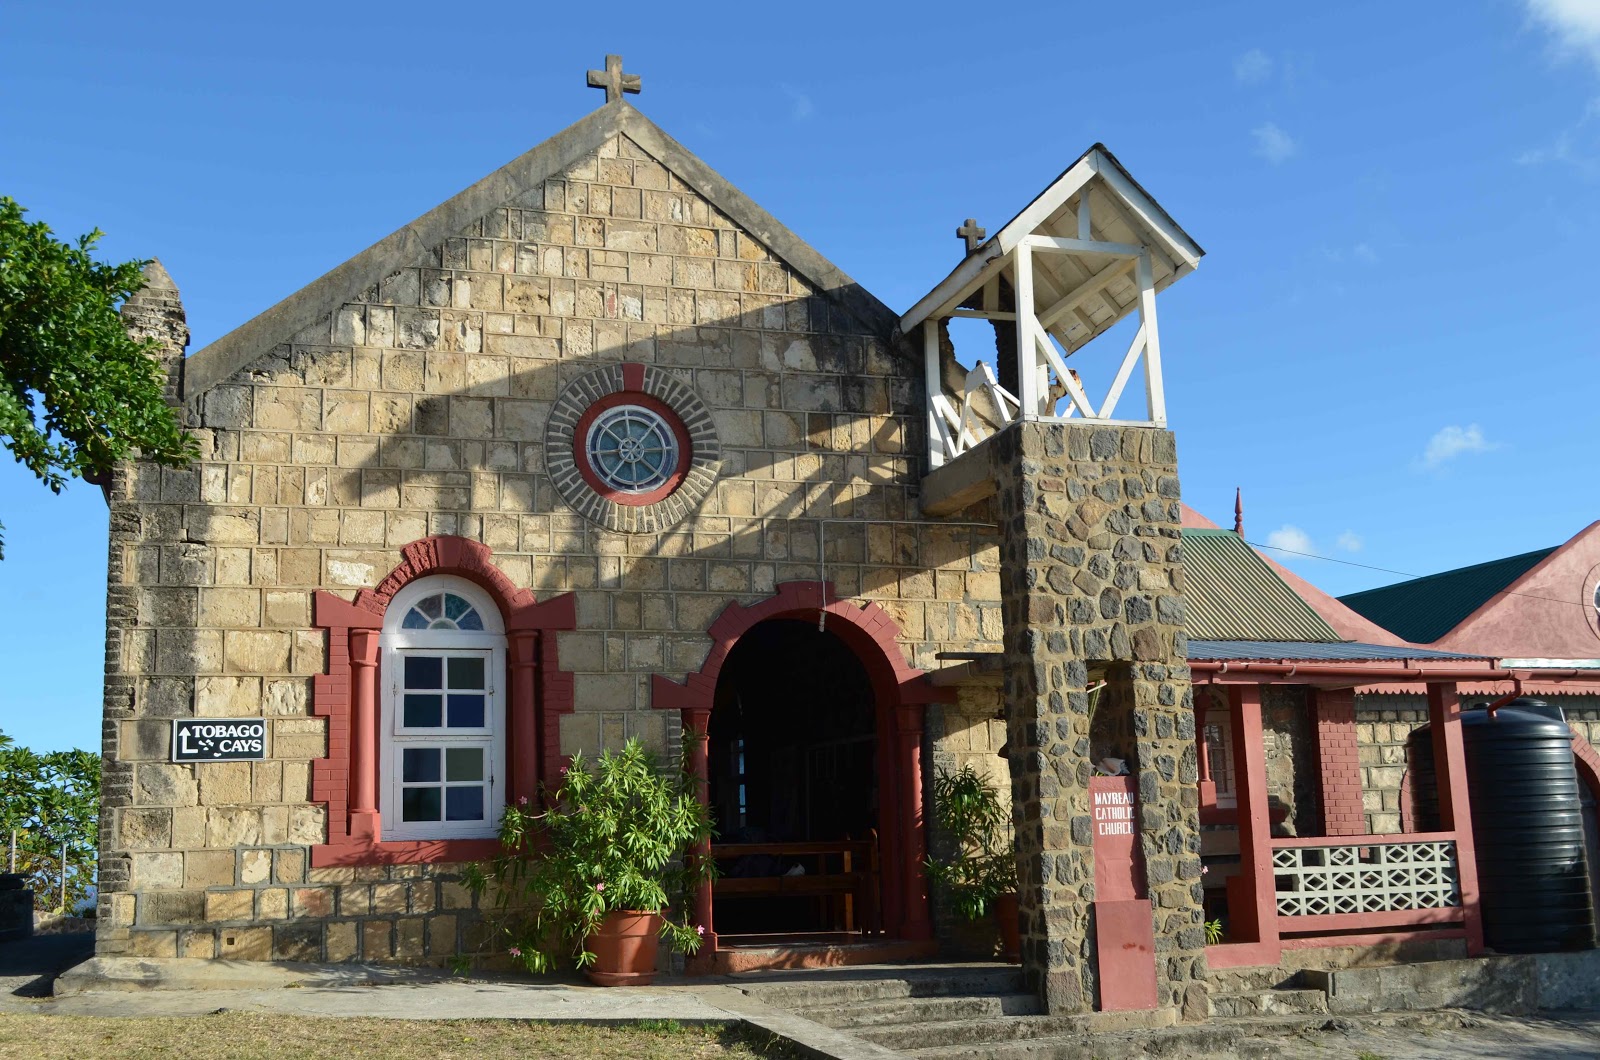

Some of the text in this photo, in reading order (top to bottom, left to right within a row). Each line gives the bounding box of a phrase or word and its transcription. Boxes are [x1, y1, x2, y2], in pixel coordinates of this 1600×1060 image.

[192, 725, 263, 738] TOBAGO
[219, 739, 262, 752] CAYS
[1094, 792, 1134, 805] MAYREAU
[1095, 806, 1135, 820] CATHOLIC
[1098, 821, 1134, 835] CHURCH
